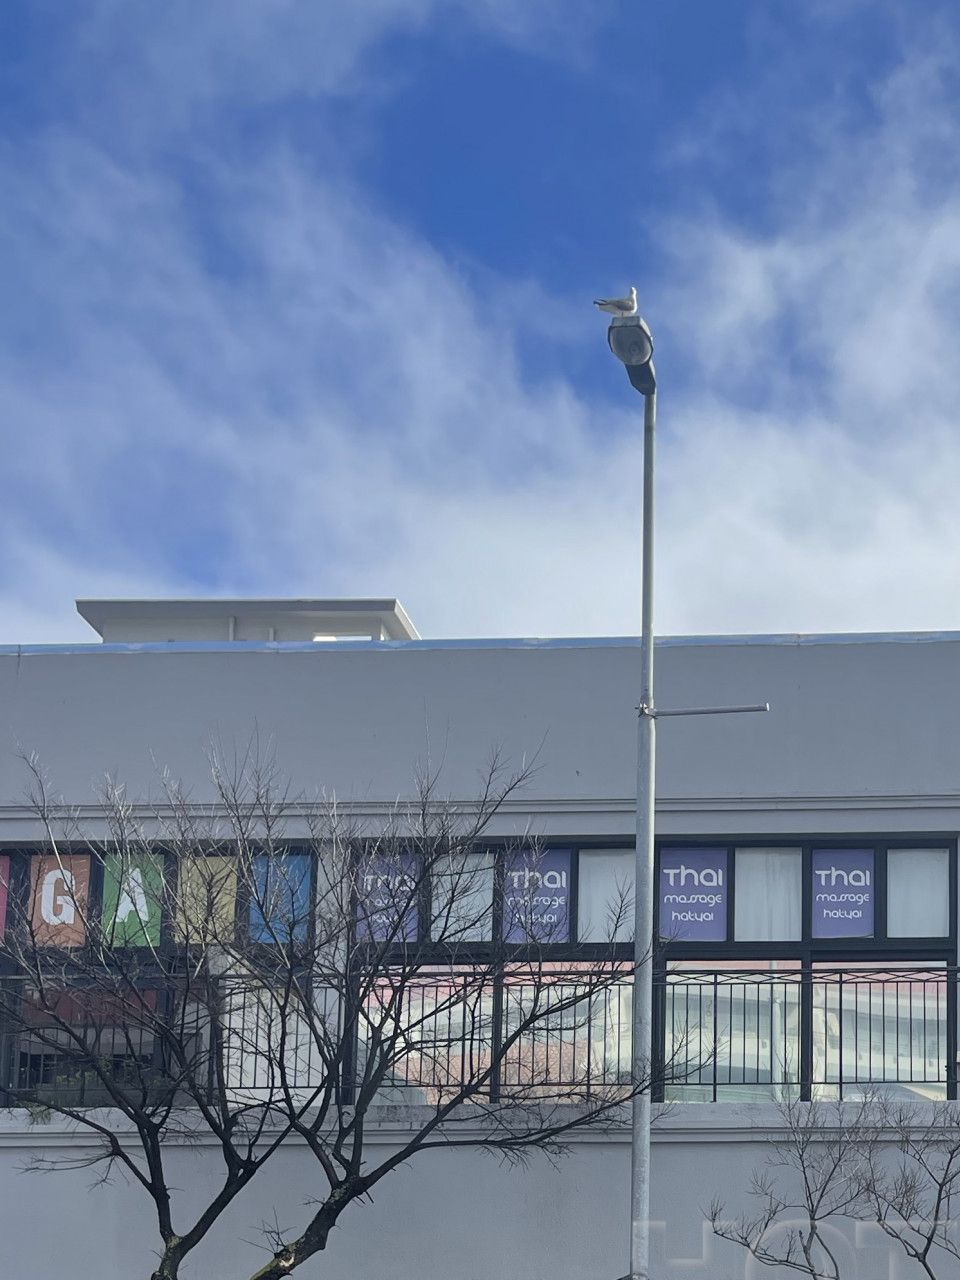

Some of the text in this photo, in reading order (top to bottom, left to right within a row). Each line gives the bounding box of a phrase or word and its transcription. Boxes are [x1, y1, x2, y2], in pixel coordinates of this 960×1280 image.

[508, 866, 566, 889] Thai
[663, 865, 723, 887] Thai
[815, 866, 870, 887] Thai
[664, 894, 722, 907] massage
[816, 893, 870, 905] massage
[672, 910, 713, 922] hatyai
[823, 908, 862, 919] hatyai
